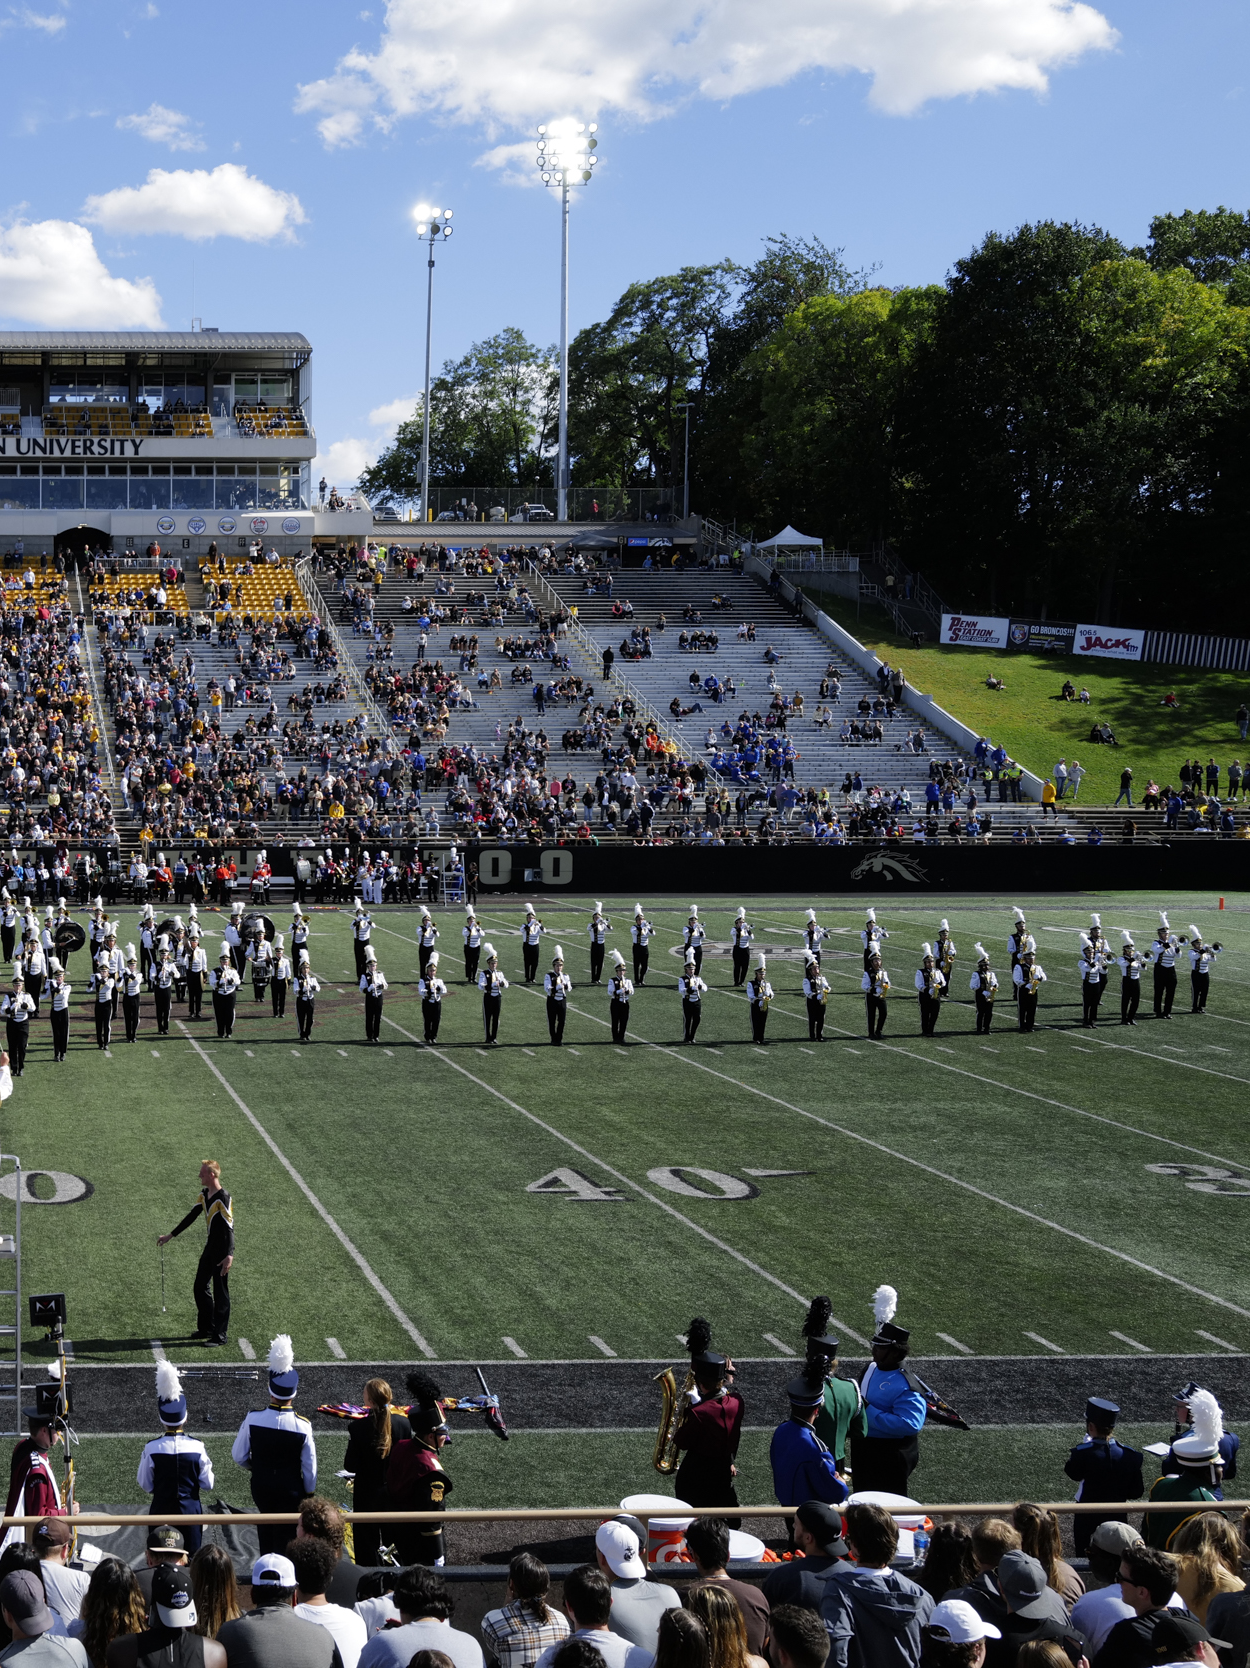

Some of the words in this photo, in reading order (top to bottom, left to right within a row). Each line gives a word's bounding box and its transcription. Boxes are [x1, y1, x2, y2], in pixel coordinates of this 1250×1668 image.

[15, 437, 144, 455] UNIVERSITY
[948, 616, 978, 631] PENN
[949, 628, 994, 642] STATION
[1031, 626, 1039, 634] GO
[1040, 626, 1074, 637] BRONCOS!!!
[1079, 636, 1133, 651] JACK
[526, 1167, 761, 1201] 40
